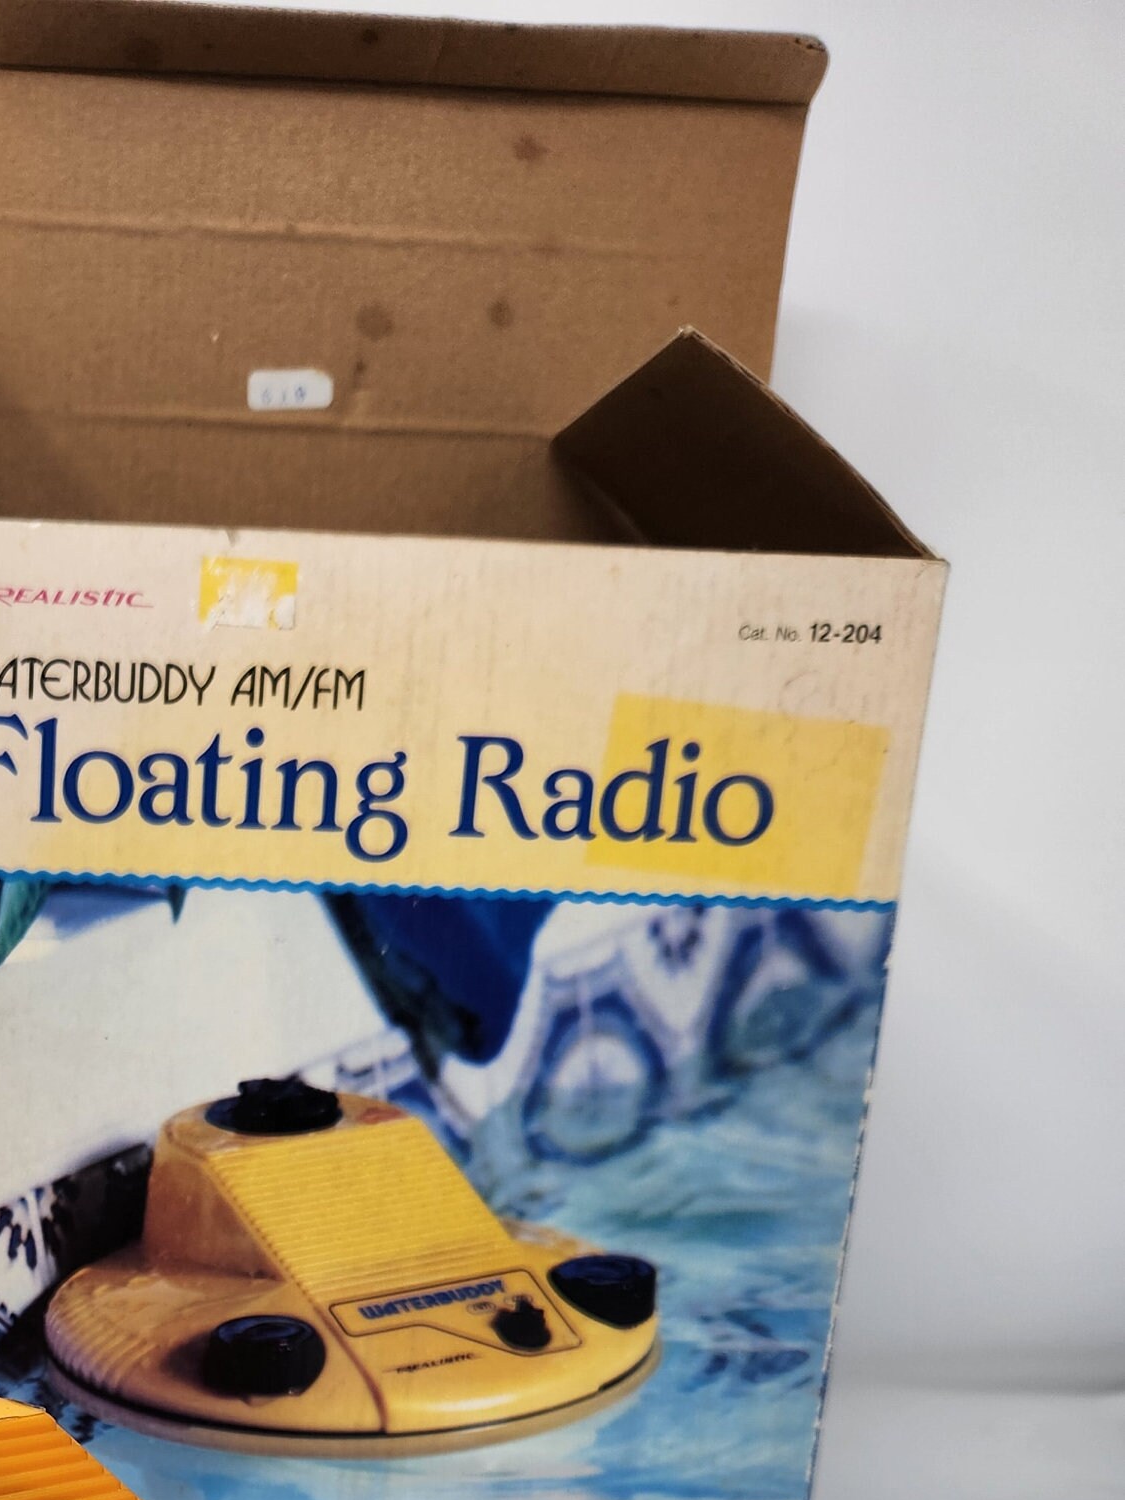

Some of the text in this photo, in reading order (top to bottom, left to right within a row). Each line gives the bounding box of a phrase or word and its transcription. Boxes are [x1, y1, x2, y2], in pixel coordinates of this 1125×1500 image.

[738, 623, 883, 644] Cat. No. 12-204
[231, 665, 366, 711] AM/FM
[454, 734, 775, 847] Radio
[358, 1279, 506, 1320] WATERBUDDY
